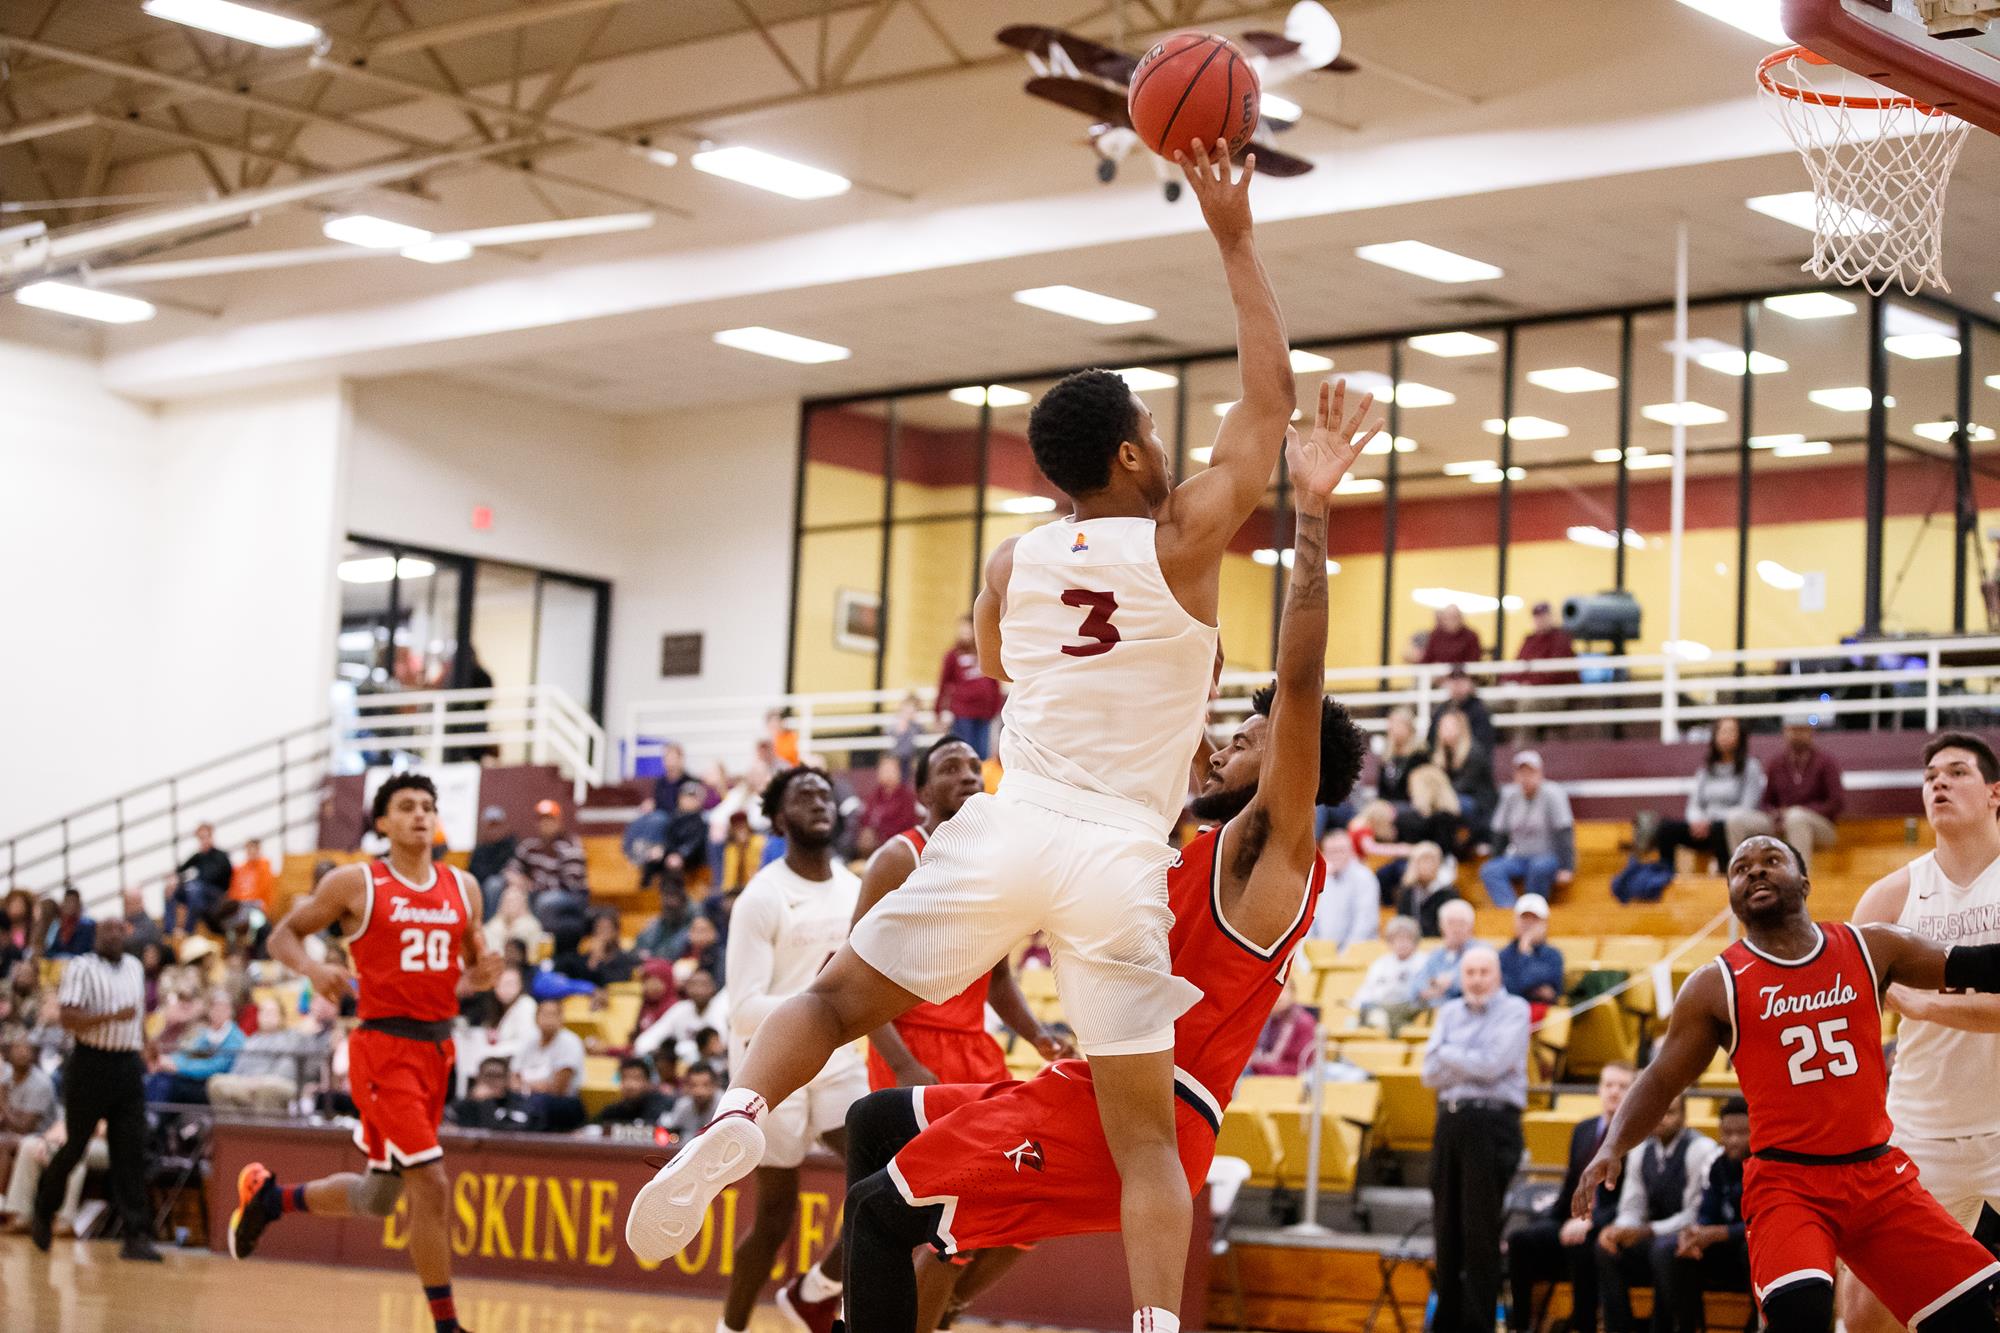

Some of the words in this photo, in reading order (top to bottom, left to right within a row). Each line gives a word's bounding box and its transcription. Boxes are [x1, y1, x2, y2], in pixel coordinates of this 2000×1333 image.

[1060, 588, 1122, 657] 3
[389, 895, 460, 925] Tornado
[401, 928, 452, 972] 20
[1759, 971, 1858, 1020] Tornado
[1779, 1017, 1859, 1086] 25
[382, 1169, 620, 1268] ESKINE
